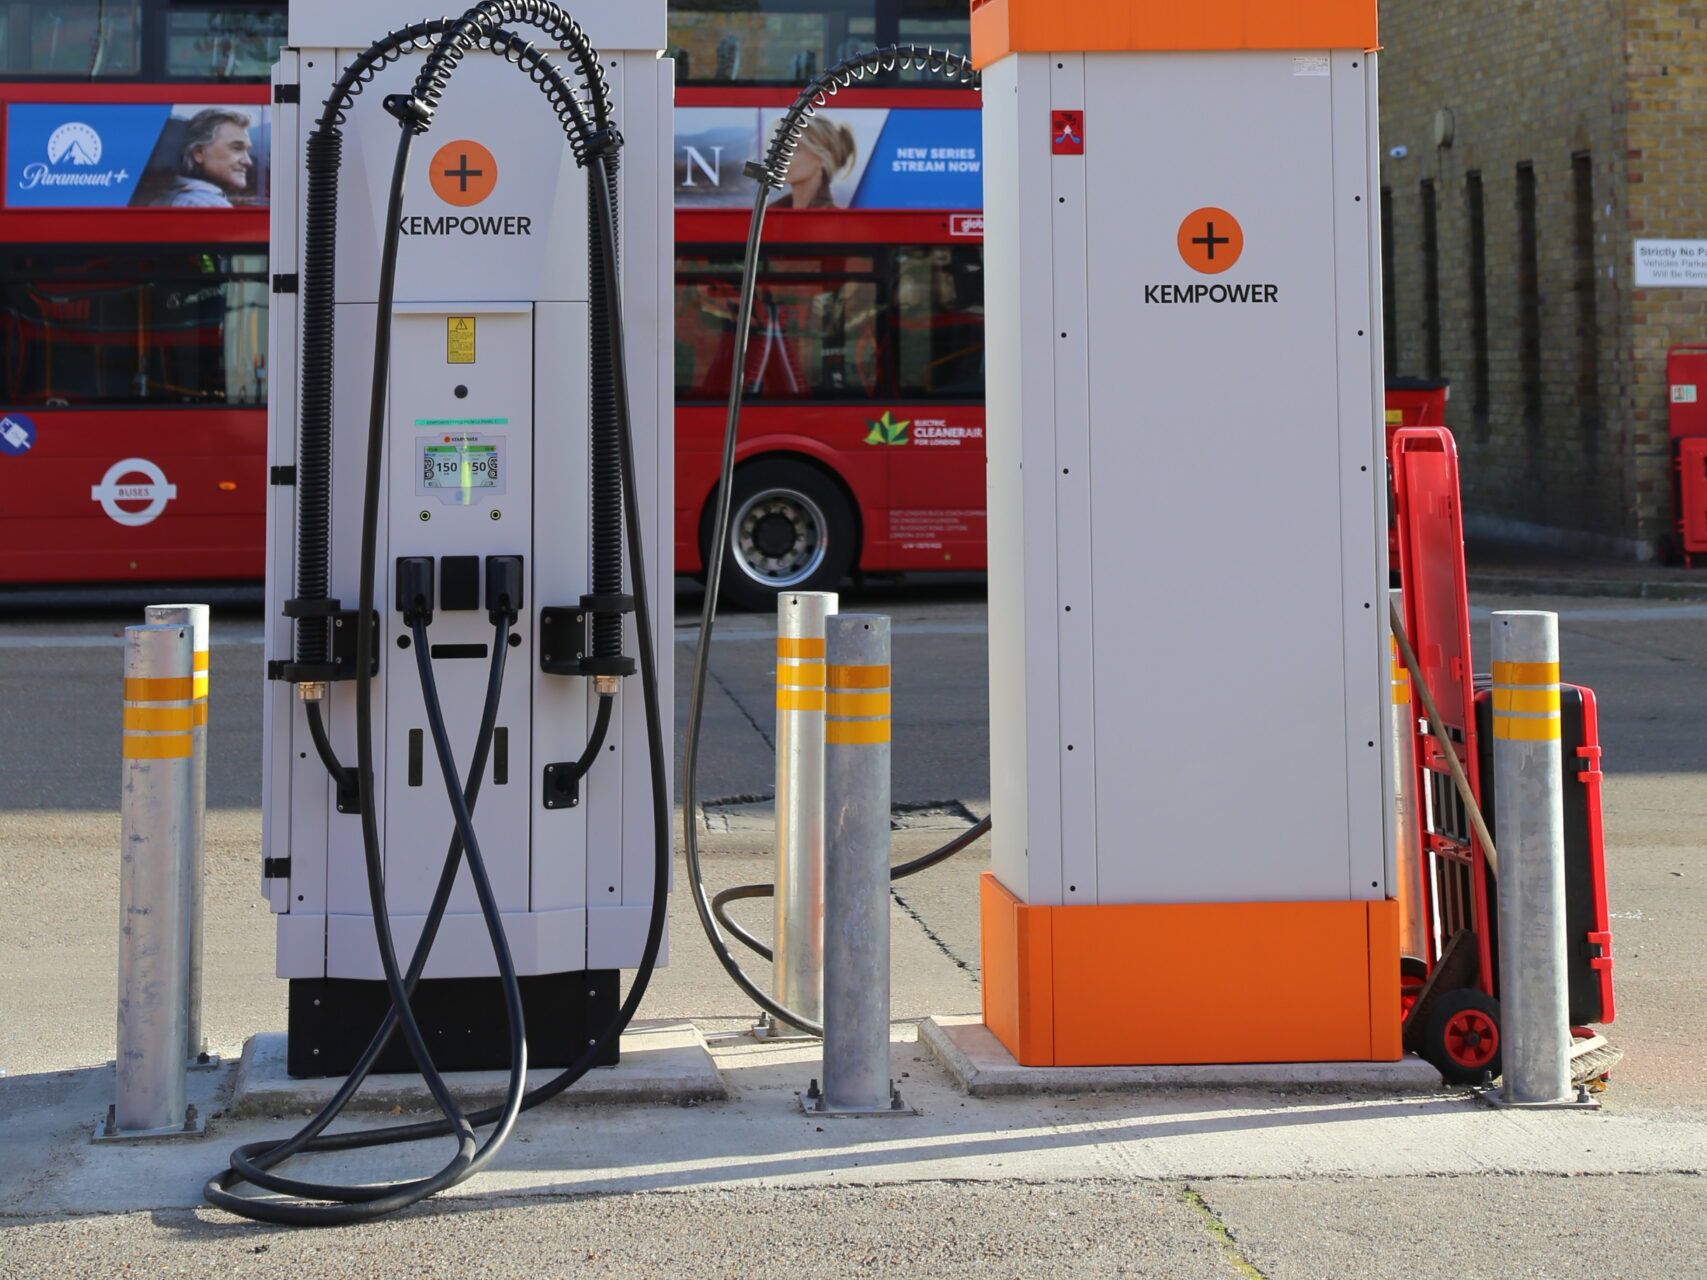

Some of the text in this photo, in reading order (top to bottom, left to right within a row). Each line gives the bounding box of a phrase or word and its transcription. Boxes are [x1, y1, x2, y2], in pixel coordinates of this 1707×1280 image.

[897, 148, 976, 160] NEW SERIES
[892, 161, 981, 172] STREAM NOW
[399, 216, 532, 235] KEMPOWER
[1640, 247, 1707, 258] Strictly No P
[1643, 260, 1679, 268] Vehicles
[1144, 284, 1279, 304] KEMPOWER
[436, 462, 458, 473] 150
[118, 487, 150, 497] BUSES
